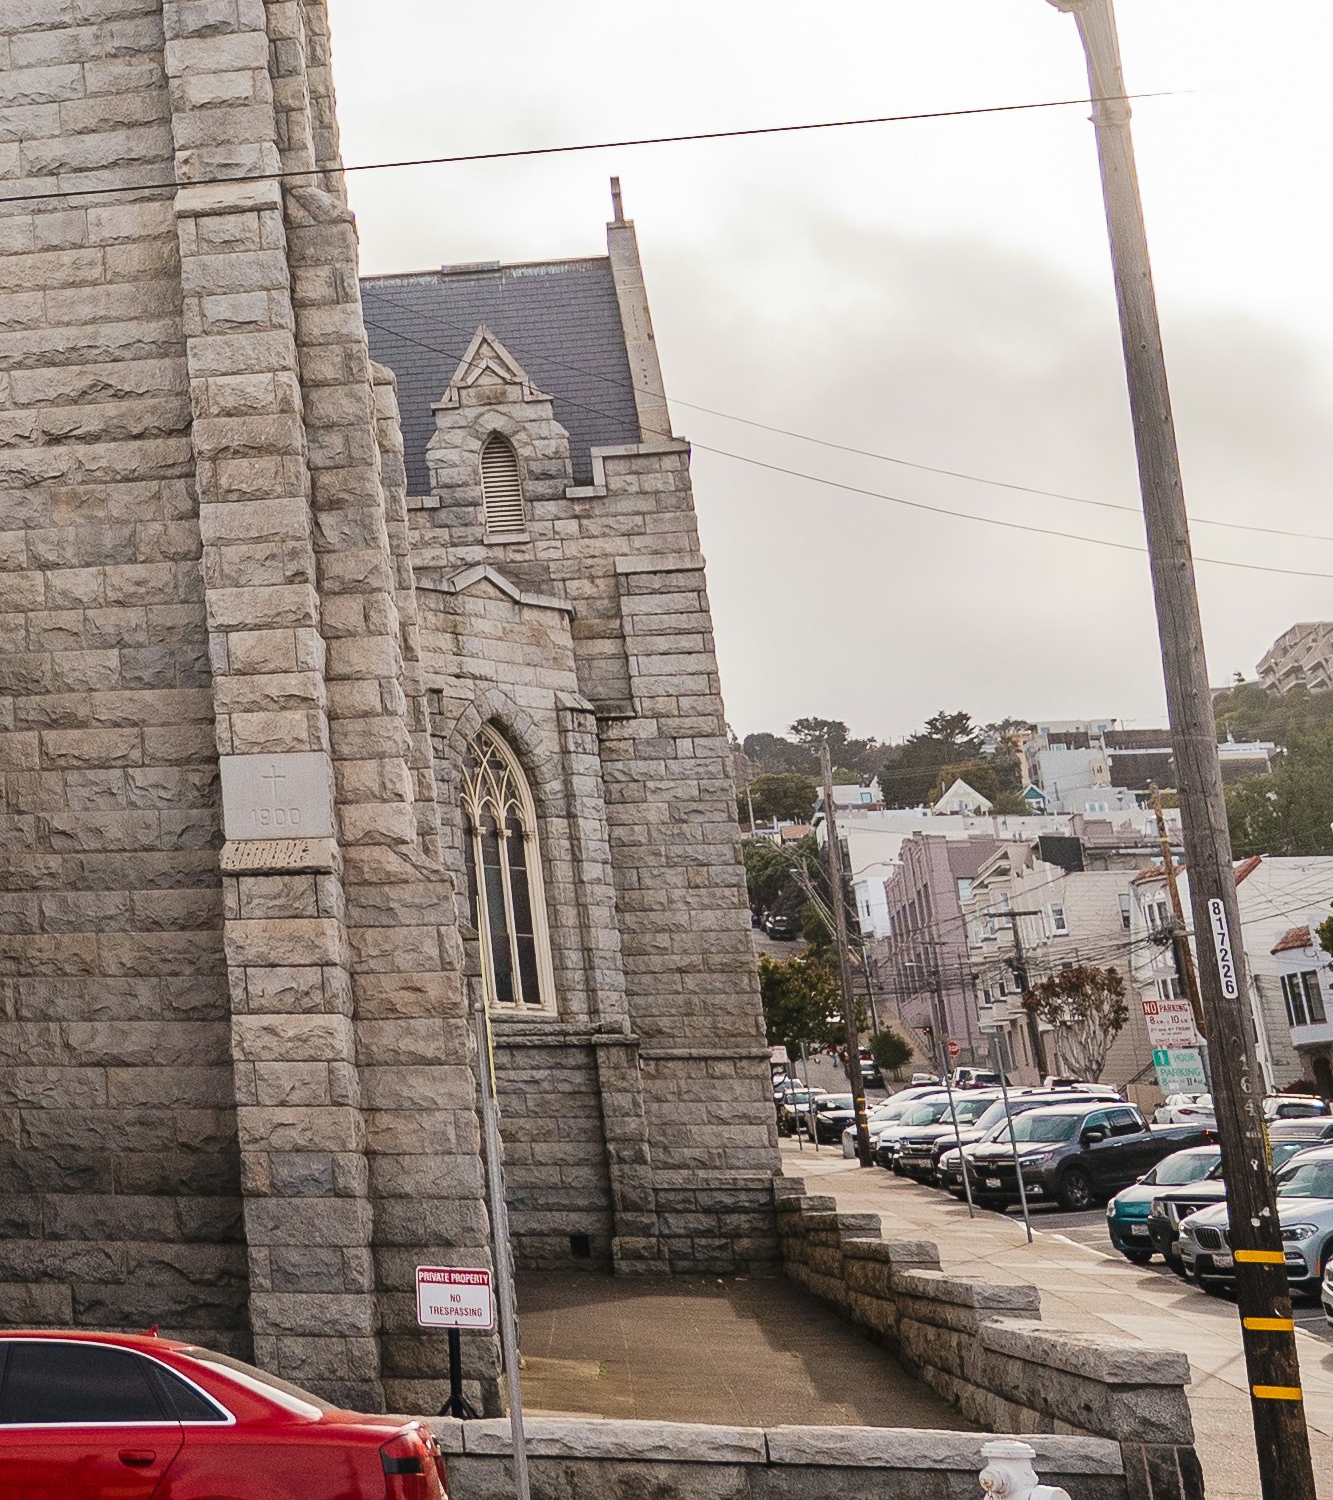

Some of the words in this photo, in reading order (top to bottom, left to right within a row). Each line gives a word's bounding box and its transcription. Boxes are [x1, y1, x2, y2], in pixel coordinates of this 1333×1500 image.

[250, 806, 301, 827] 1900
[1212, 901, 1235, 994] 817226
[1143, 1001, 1157, 1014] NO
[1159, 1003, 1188, 1013] PARKING
[1160, 1067, 1201, 1077] PARKING
[418, 1271, 449, 1282] PRIVATE
[450, 1273, 489, 1284] PROPERTY
[450, 1293, 461, 1303] NO
[429, 1305, 483, 1317] TRESPASSING
